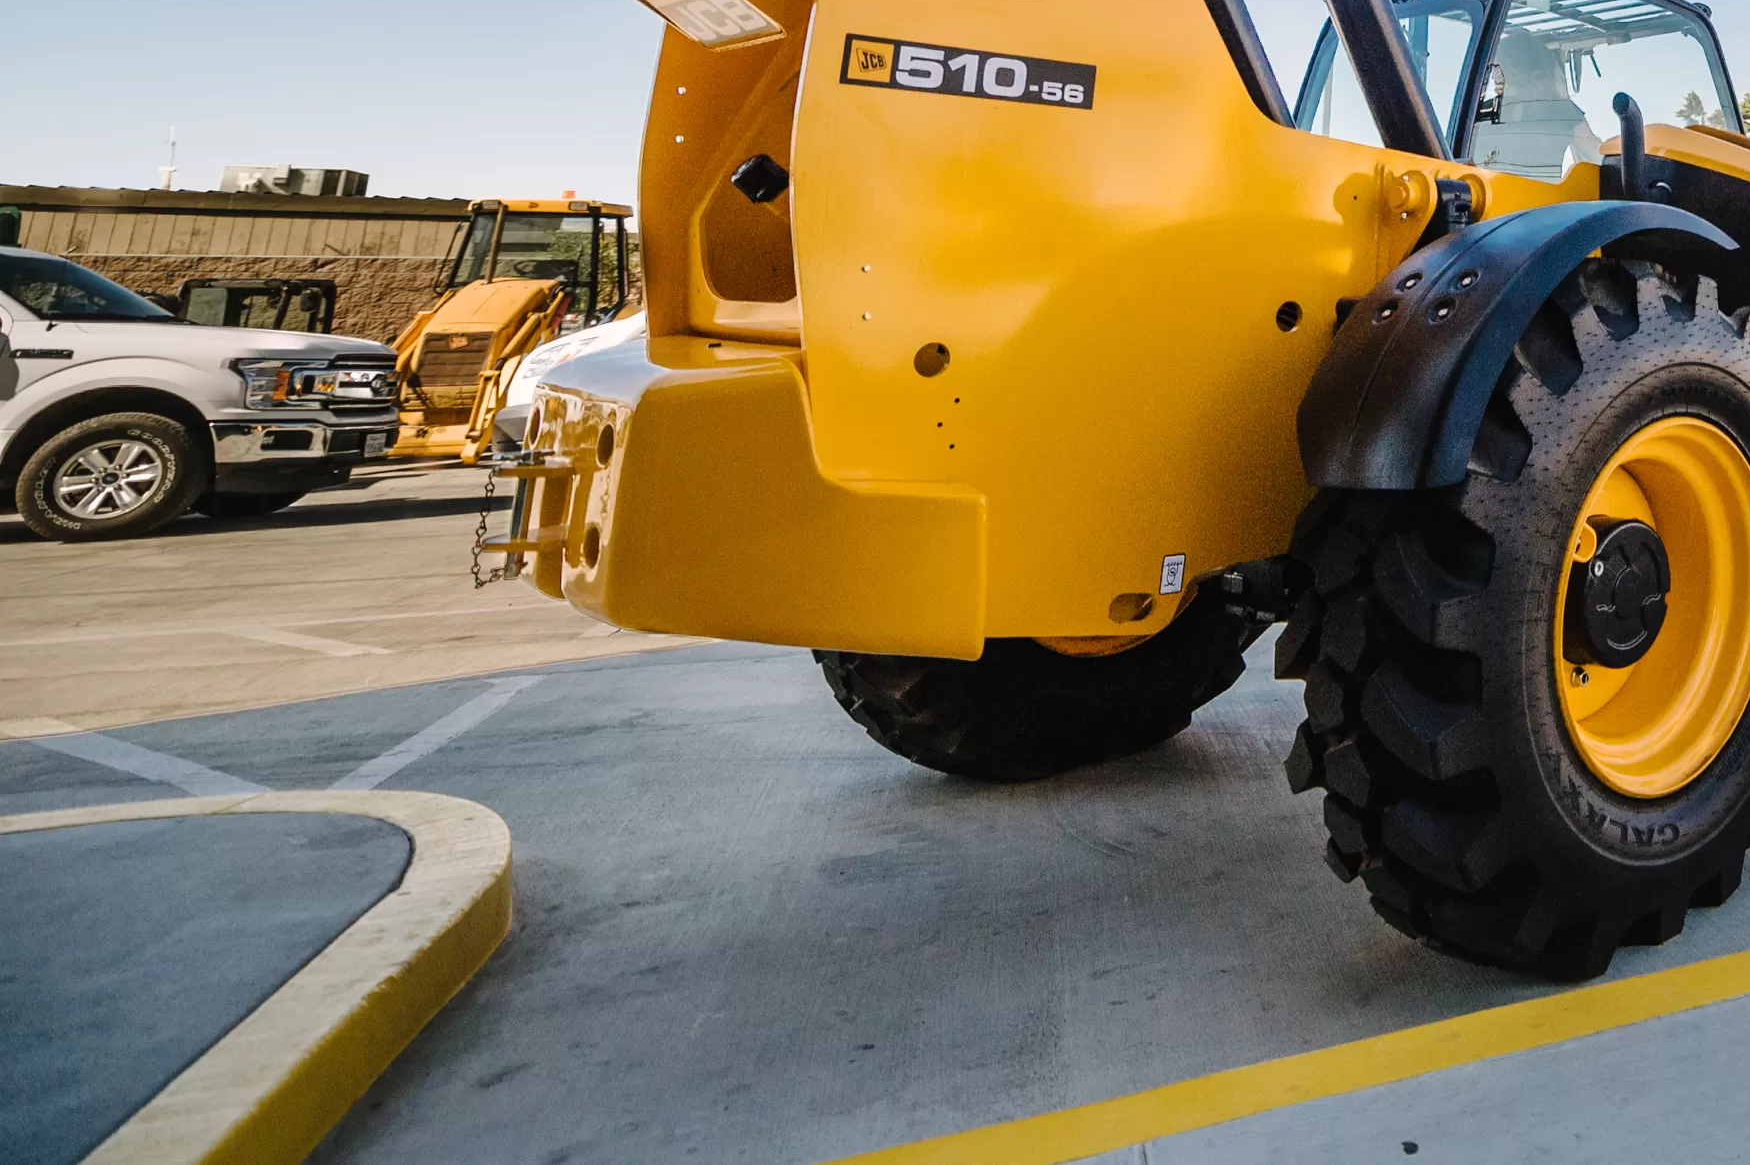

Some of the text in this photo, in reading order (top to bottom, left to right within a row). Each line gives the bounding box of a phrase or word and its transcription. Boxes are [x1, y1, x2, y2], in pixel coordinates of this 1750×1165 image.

[861, 45, 1084, 104] JCB 510-56
[127, 429, 176, 503] GOODYEAR
[1539, 748, 1680, 846] GALAXY
